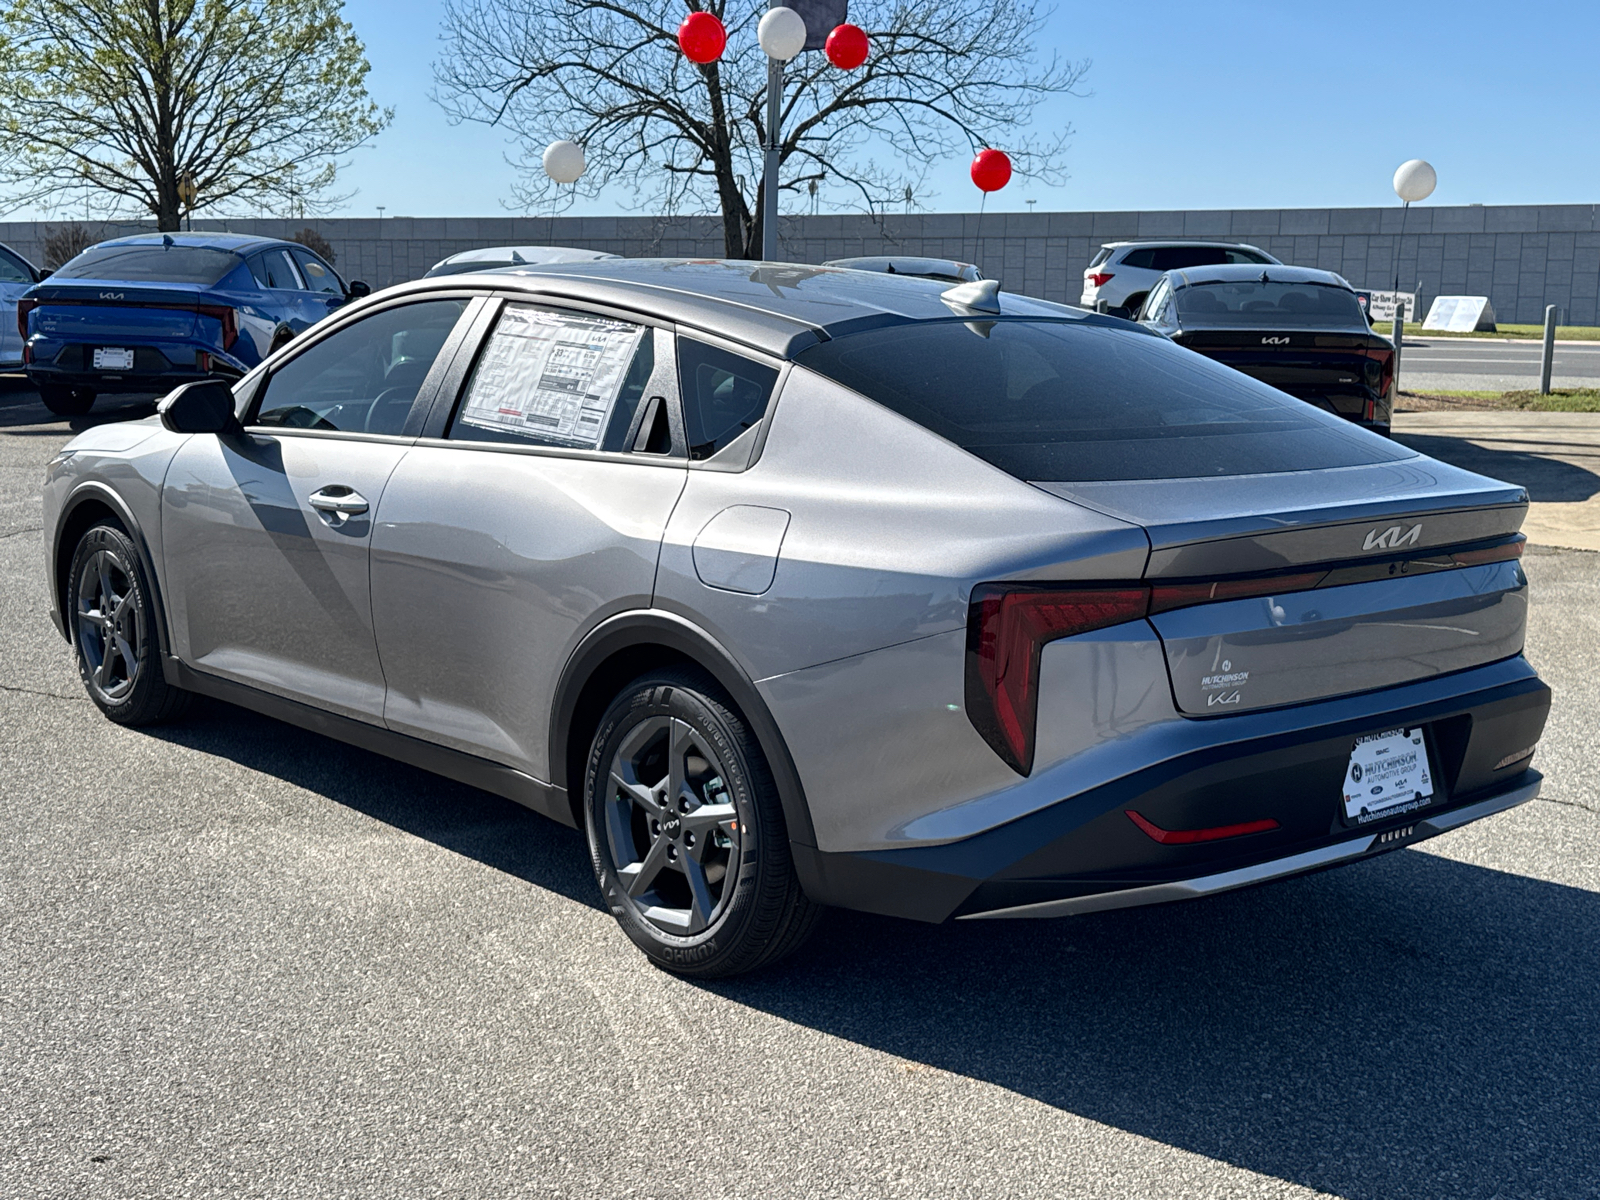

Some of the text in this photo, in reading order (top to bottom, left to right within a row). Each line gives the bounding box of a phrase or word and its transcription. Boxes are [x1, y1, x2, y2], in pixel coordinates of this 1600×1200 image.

[1362, 524, 1423, 551] KIA
[1201, 671, 1250, 685] HUTCHINSON
[1364, 751, 1418, 777] HUTCHINSON
[1366, 763, 1417, 785] AUTOMOTIVE GROUP
[662, 938, 719, 963] KUMHO
